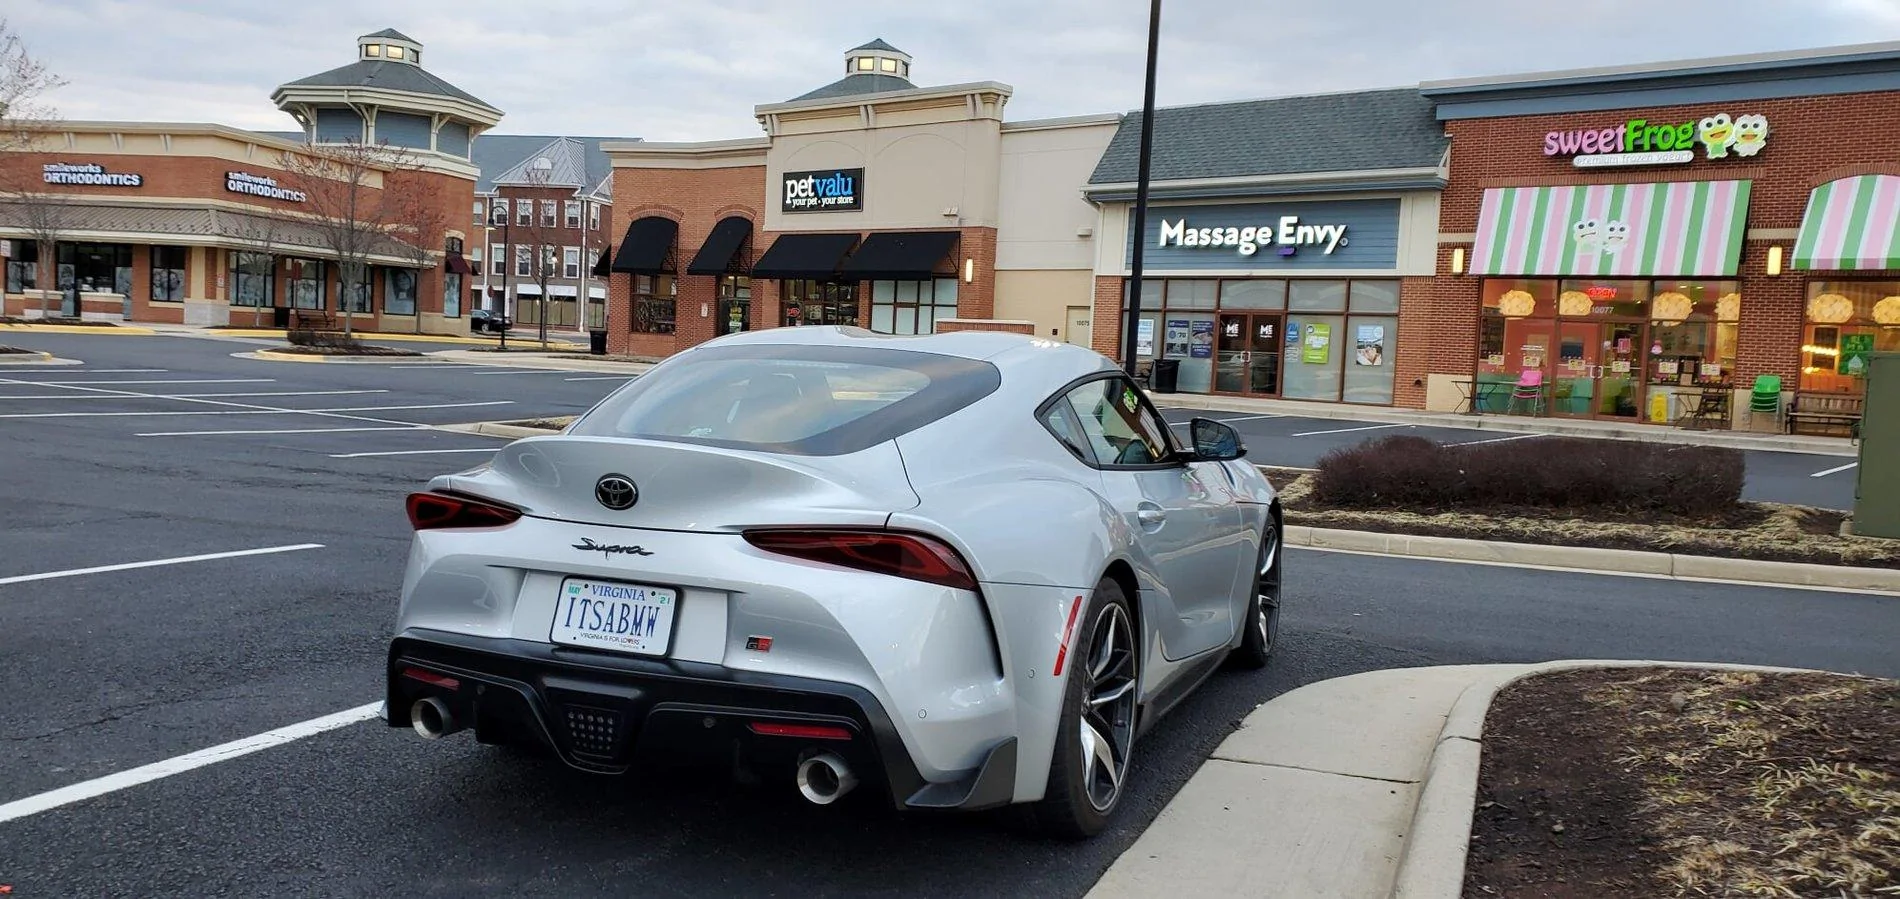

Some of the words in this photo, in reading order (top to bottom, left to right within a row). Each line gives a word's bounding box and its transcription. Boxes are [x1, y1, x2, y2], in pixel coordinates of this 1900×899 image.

[1544, 119, 1694, 155] sweetFrog
[1624, 154, 1653, 164] frozen
[43, 163, 101, 172] smileworks
[43, 173, 141, 186] ORTHODONTICS
[228, 172, 277, 187] smileworks
[227, 183, 306, 202] ORTHODONTICS
[791, 198, 806, 208] your
[807, 197, 818, 207] pet
[821, 197, 836, 207] your
[837, 196, 854, 204] store
[1160, 218, 1272, 256] Massage
[1279, 216, 1346, 254] Envy
[1591, 306, 1614, 314] 10077
[572, 537, 654, 560] Supra
[568, 586, 581, 595] MAY
[592, 585, 646, 601] VIRGINIA
[659, 597, 670, 605] 21
[565, 597, 661, 638] ITSABMW
[580, 632, 604, 641] VIRGINIA
[609, 636, 620, 644] FOR
